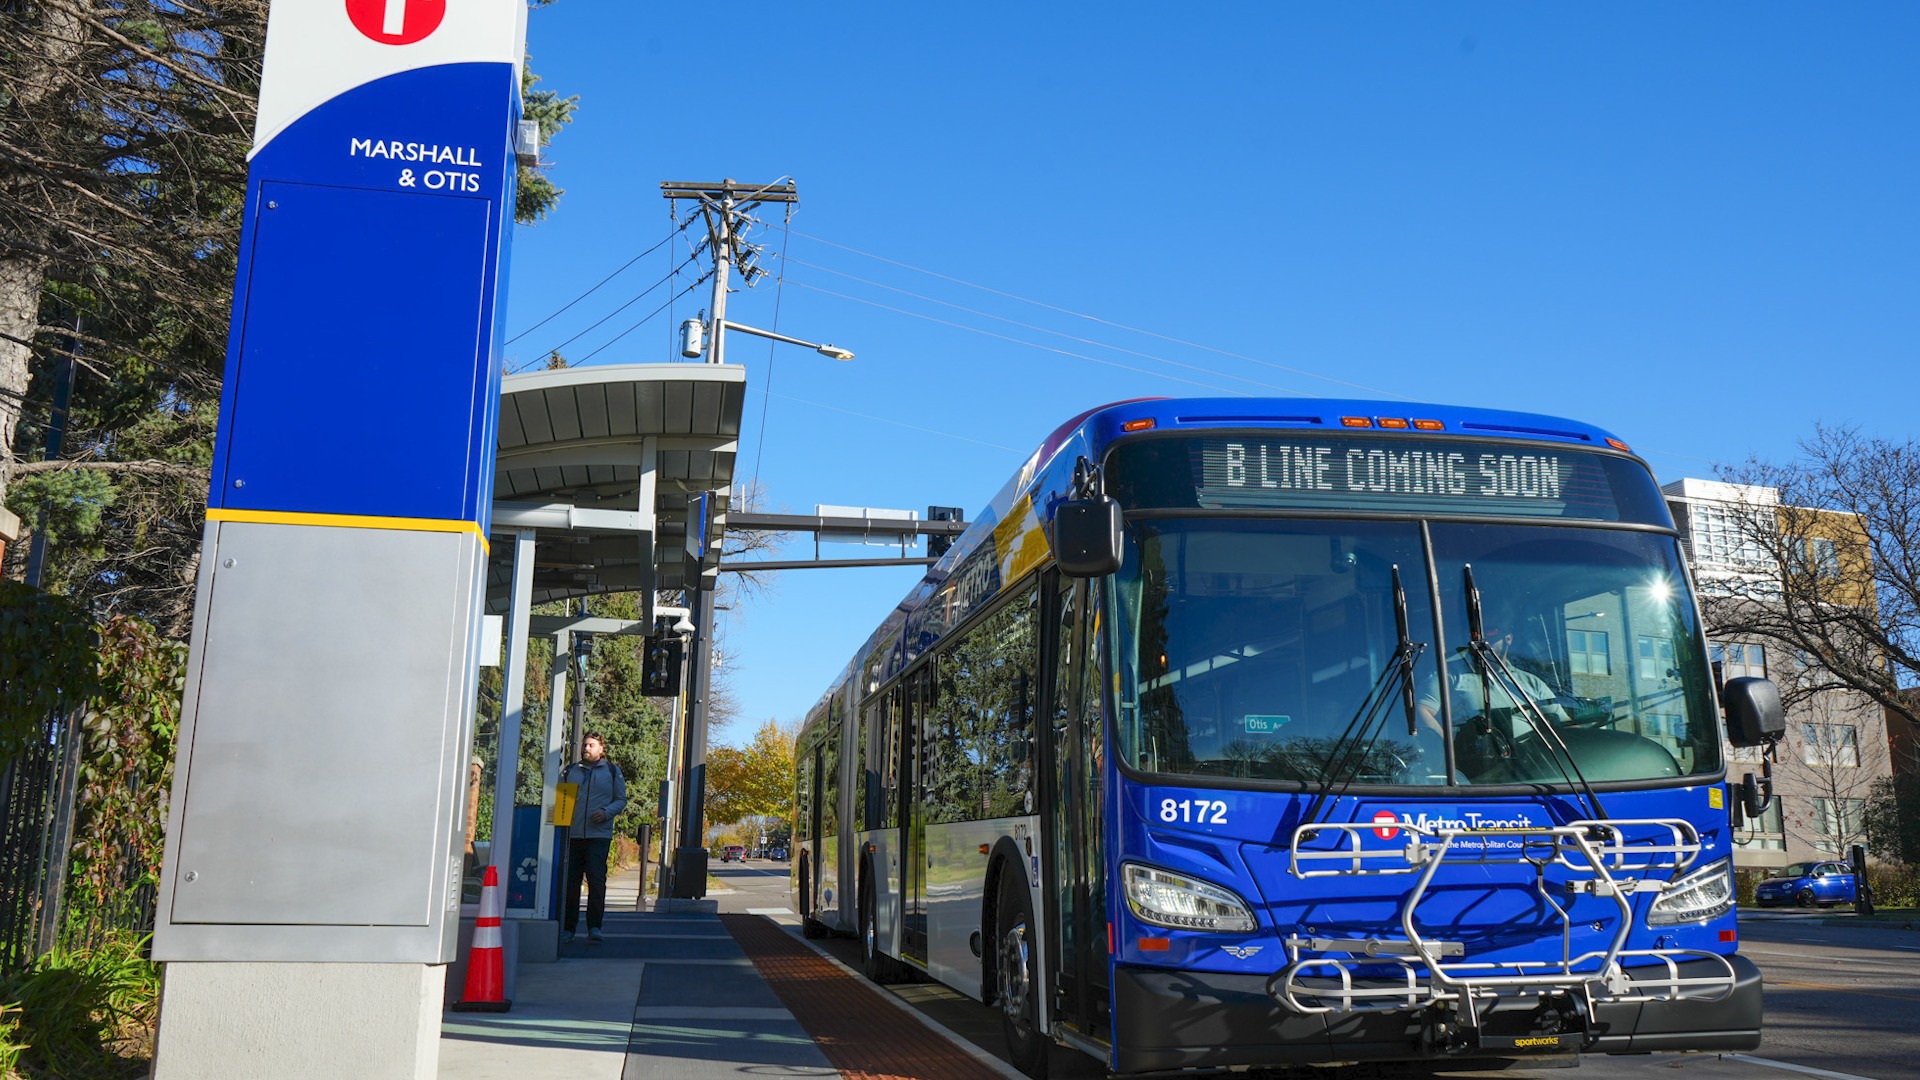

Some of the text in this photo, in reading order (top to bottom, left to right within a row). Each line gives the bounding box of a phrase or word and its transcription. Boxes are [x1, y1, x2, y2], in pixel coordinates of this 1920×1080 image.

[350, 137, 482, 167] MARSHALL
[398, 168, 480, 192] & OTIS
[1227, 443, 1560, 499] B LINE COMING SOON
[1249, 719, 1268, 730] Otis
[1160, 798, 1228, 825] 8172
[1014, 824, 1027, 841] 8172
[1402, 812, 1466, 837] Metro
[1465, 812, 1532, 830] Transit
[1514, 1036, 1559, 1048] sportworks
